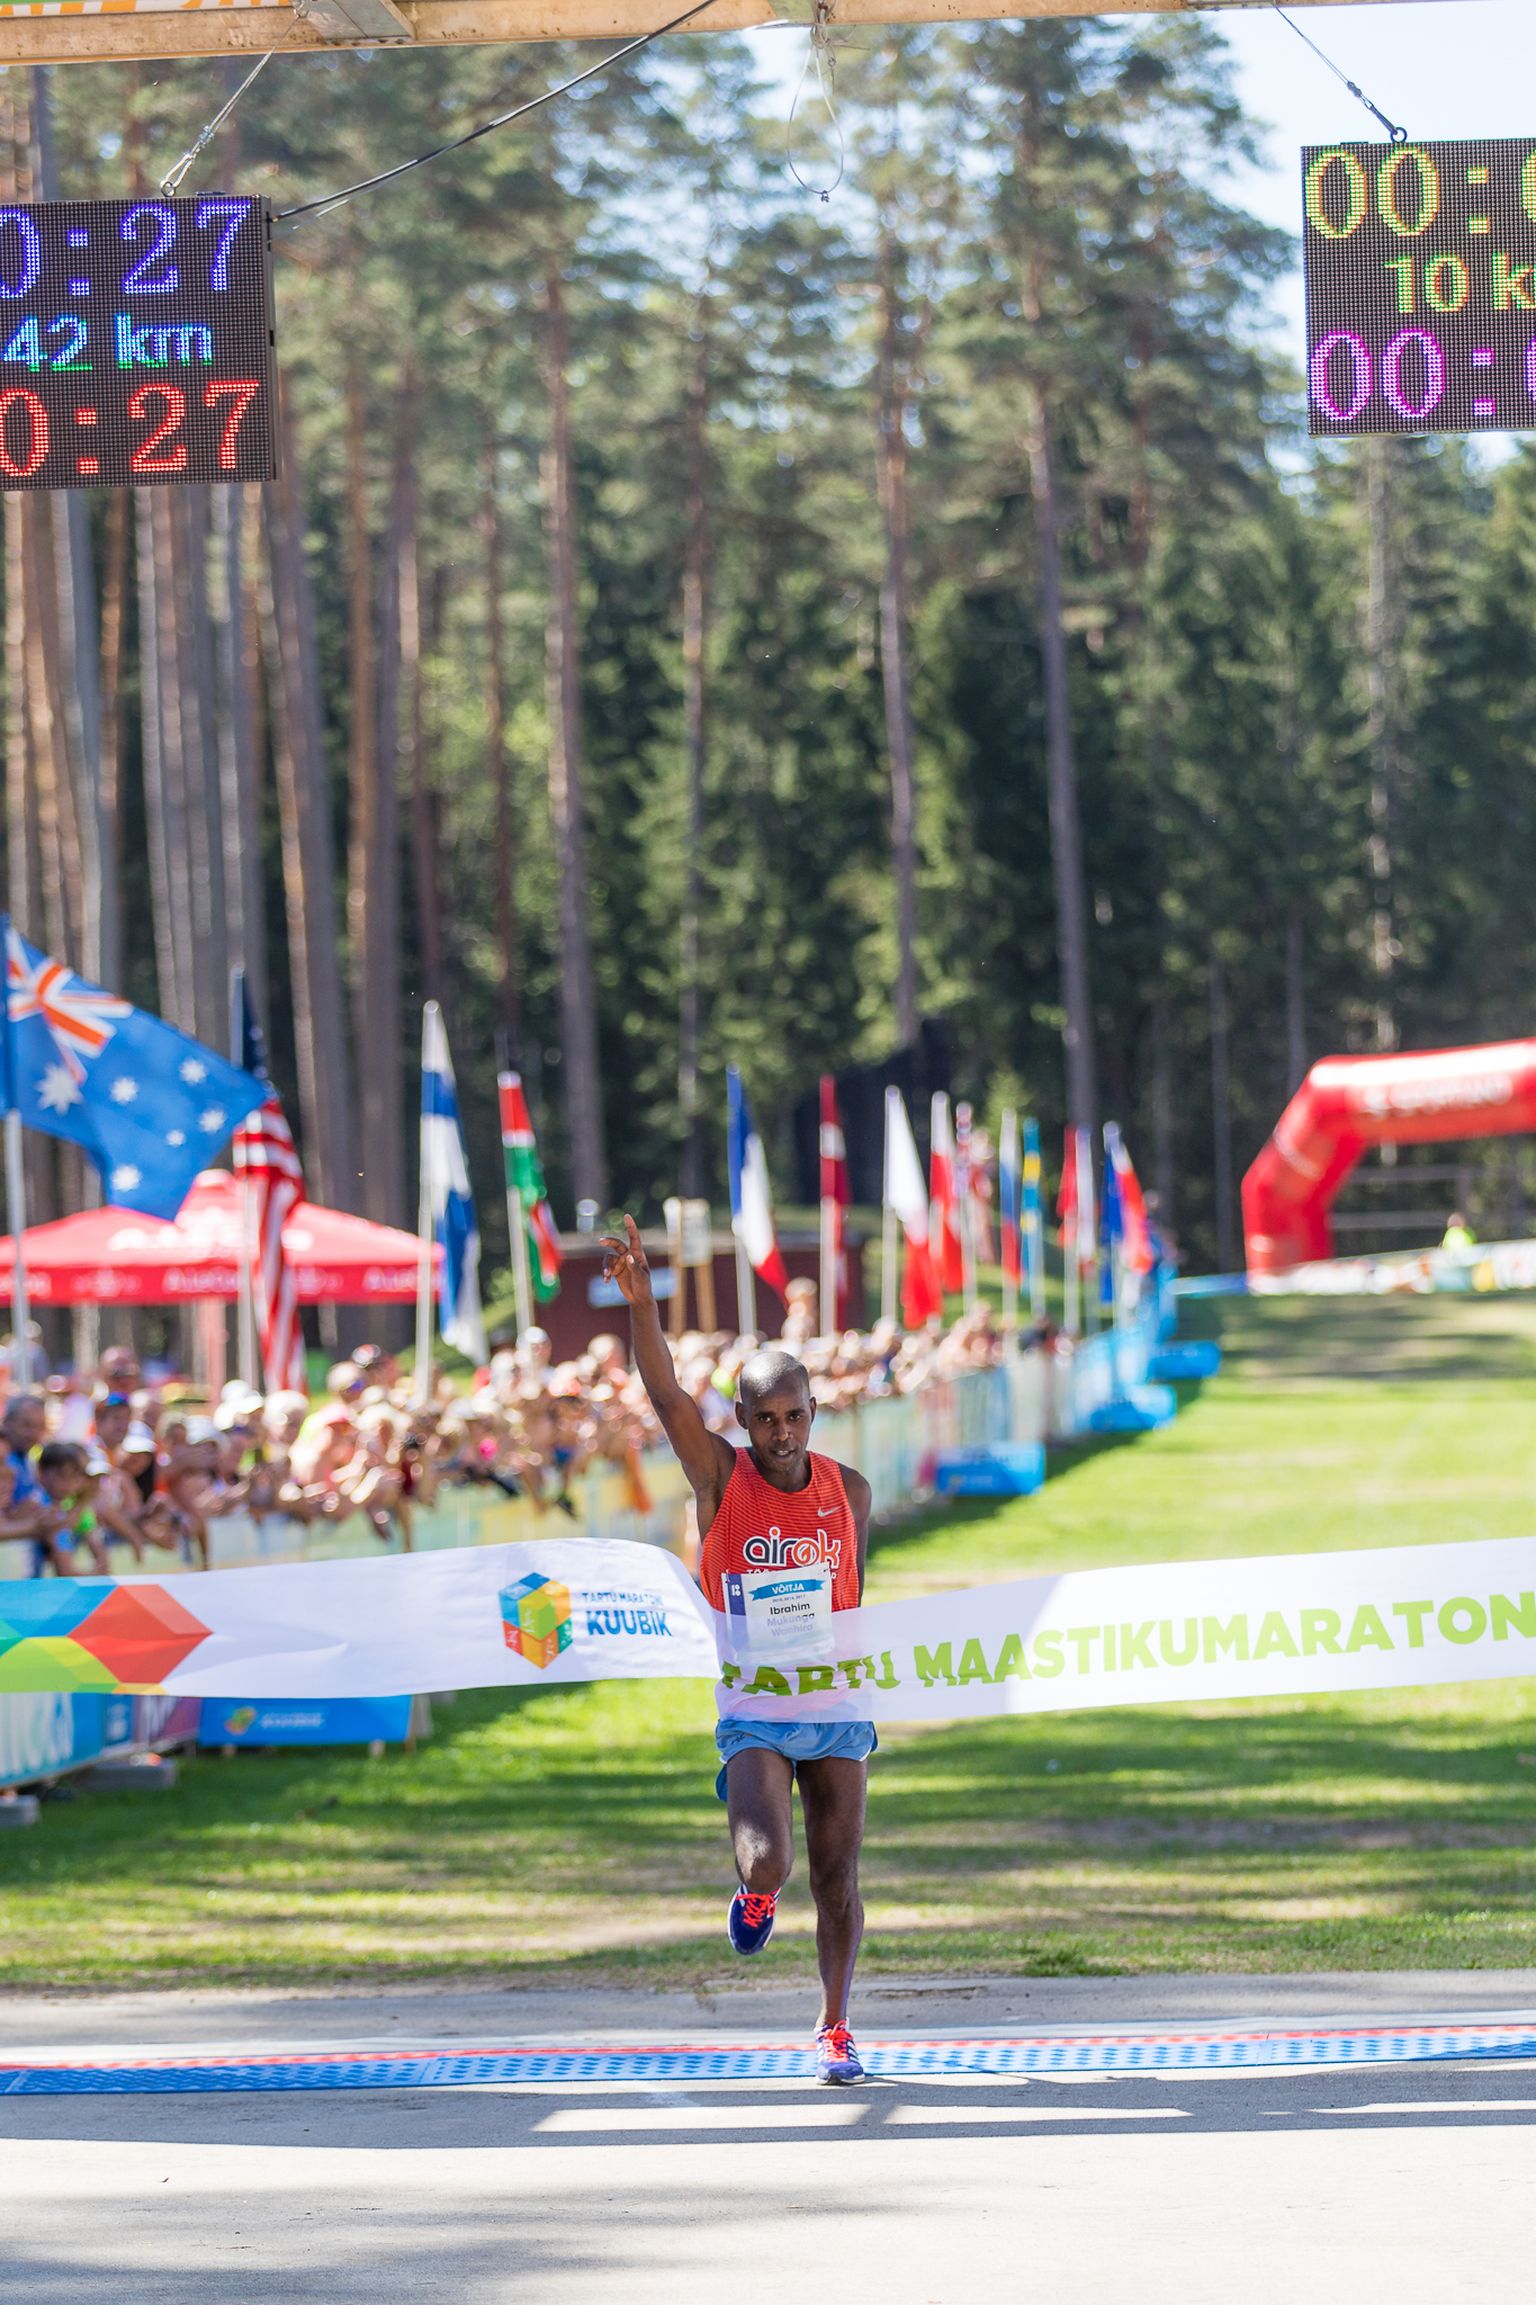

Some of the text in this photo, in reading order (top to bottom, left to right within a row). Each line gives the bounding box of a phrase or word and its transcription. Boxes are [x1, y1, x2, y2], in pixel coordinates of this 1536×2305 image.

[1304, 147, 1536, 240] 00:
[1384, 254, 1470, 314] 10
[3, 312, 213, 373] 42 km
[1309, 328, 1536, 421] 00:
[743, 1526, 842, 1570] airok
[586, 1610, 673, 1637] KUUBIK
[769, 1602, 811, 1616] Ibrahim
[914, 1591, 1535, 1688] MAASTIKUMARATON
